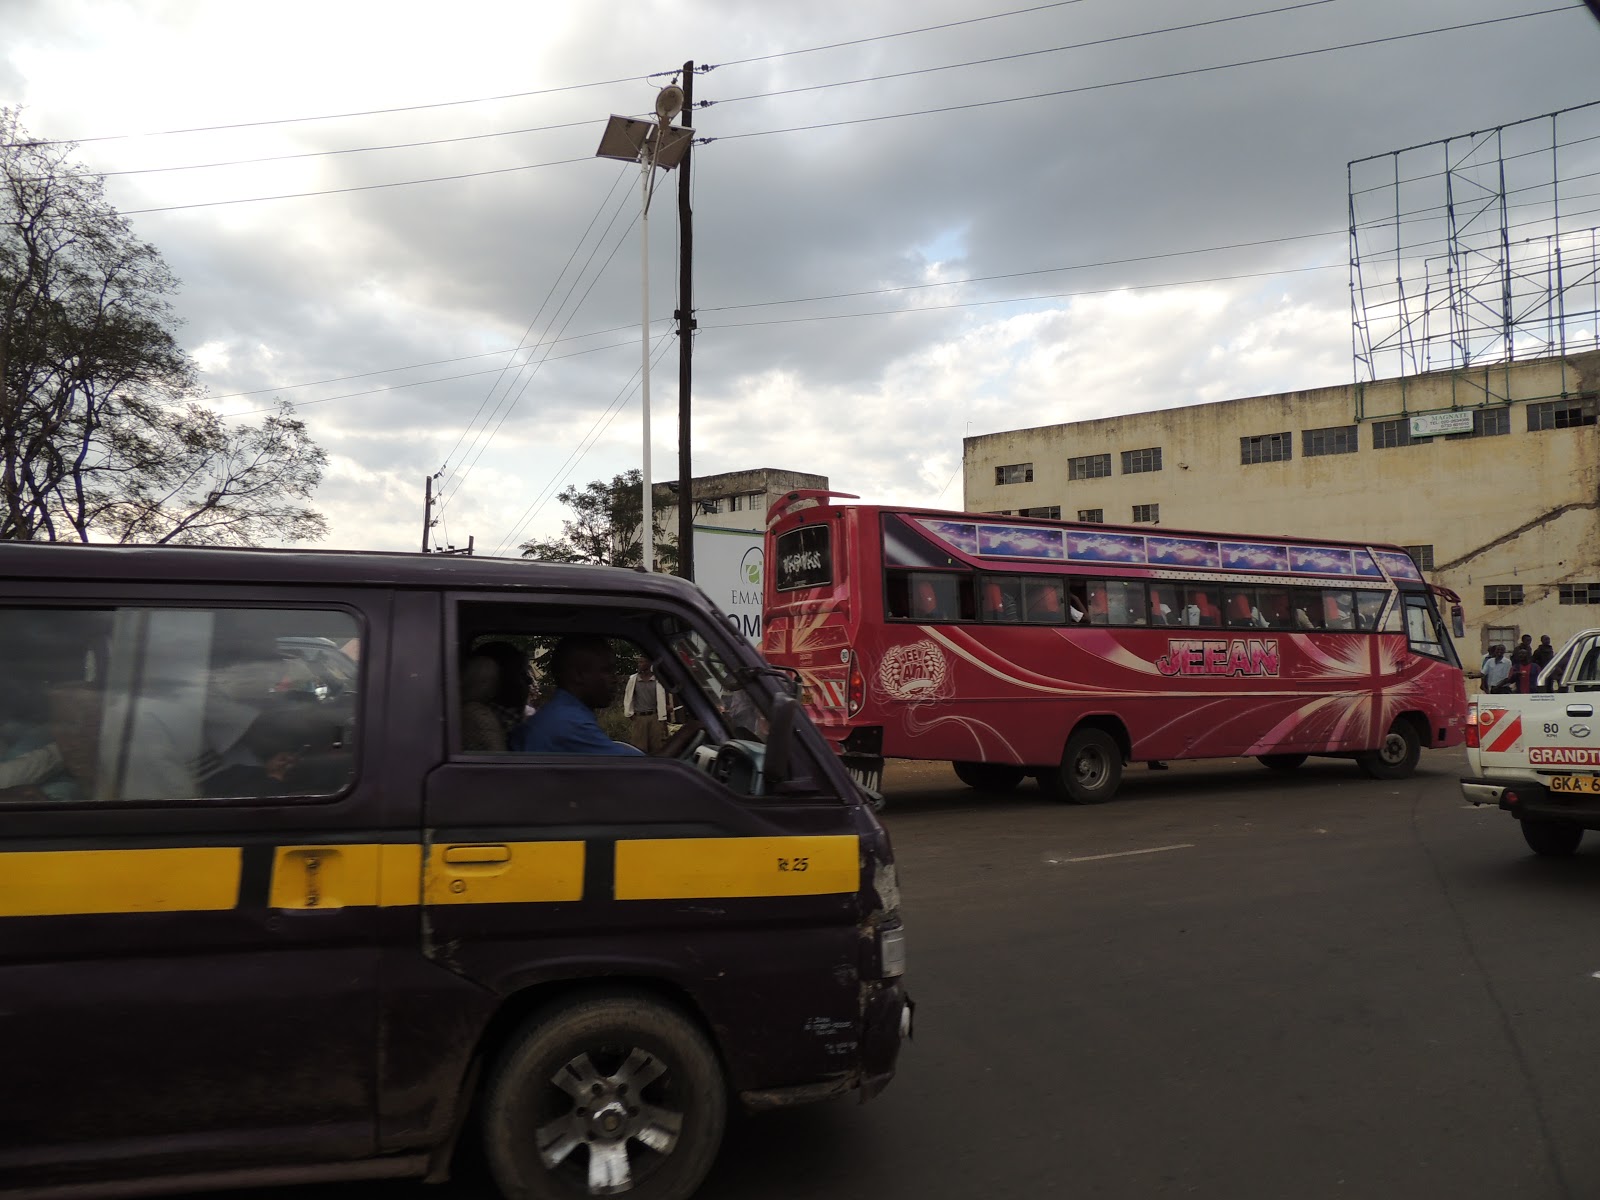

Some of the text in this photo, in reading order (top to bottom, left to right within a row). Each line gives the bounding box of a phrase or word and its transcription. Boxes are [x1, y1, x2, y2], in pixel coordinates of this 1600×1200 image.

[1156, 638, 1279, 677] JEEAN
[1543, 723, 1559, 734] 80
[1530, 749, 1600, 763] GRANDT
[1552, 777, 1582, 791] GKA
